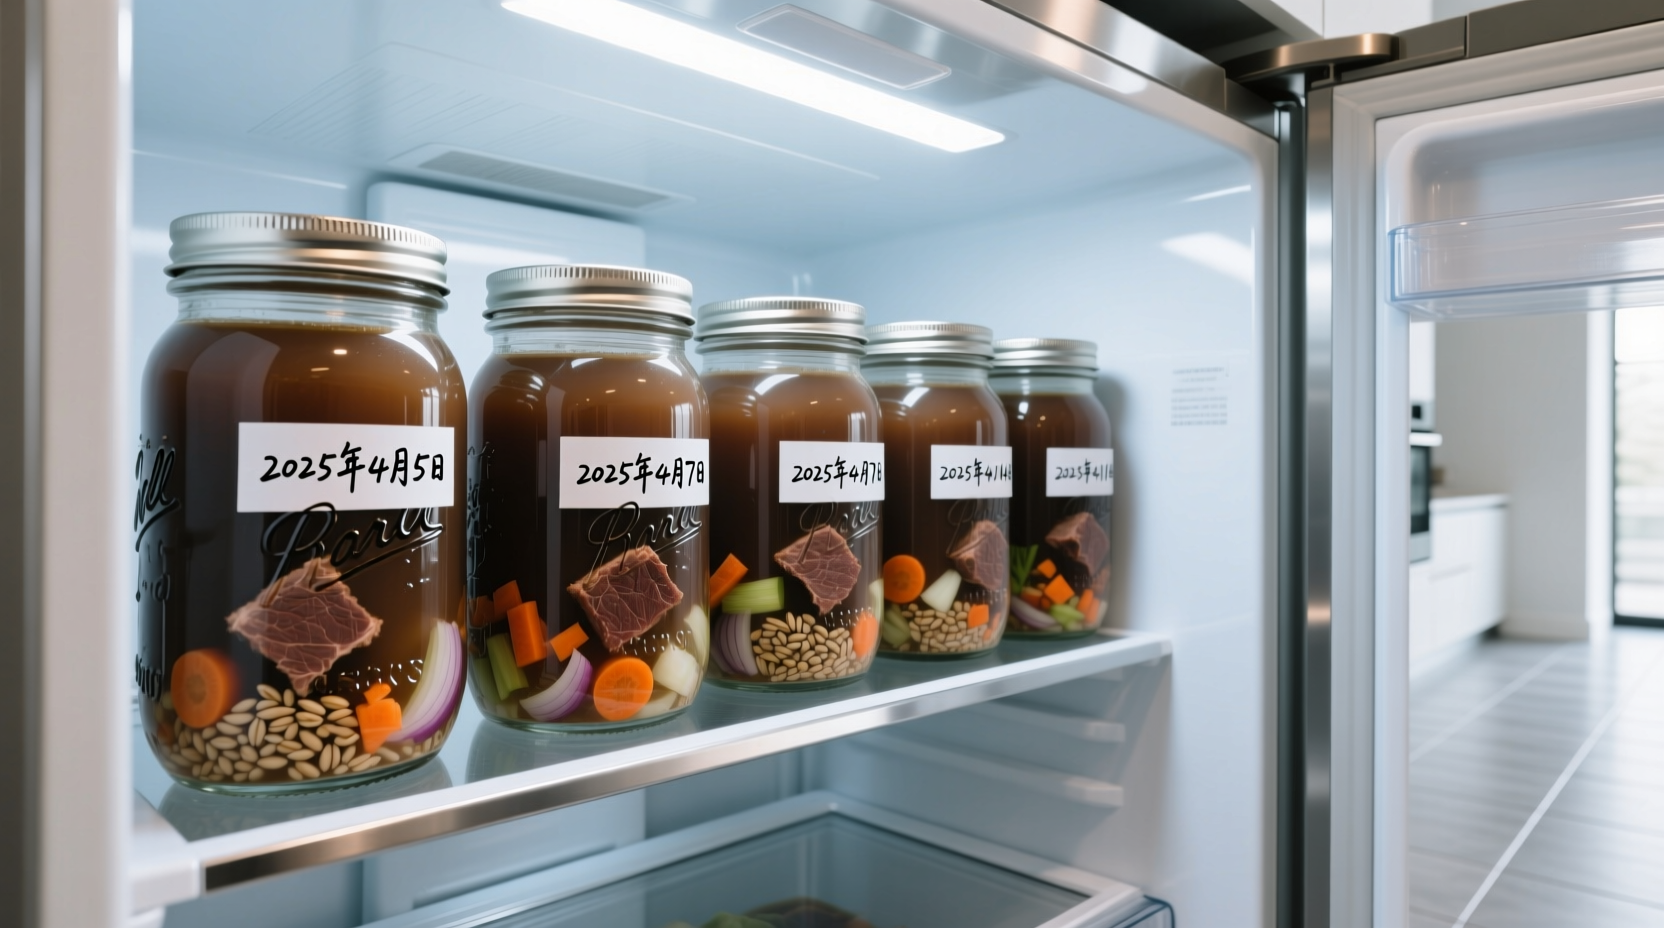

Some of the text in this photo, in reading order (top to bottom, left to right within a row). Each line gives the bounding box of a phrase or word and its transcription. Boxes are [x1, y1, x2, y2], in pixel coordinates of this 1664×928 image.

[260, 441, 444, 493] 2025年4月5日
[576, 452, 704, 494] 2025年4月7日
[791, 456, 882, 489] 2025年4月7日
